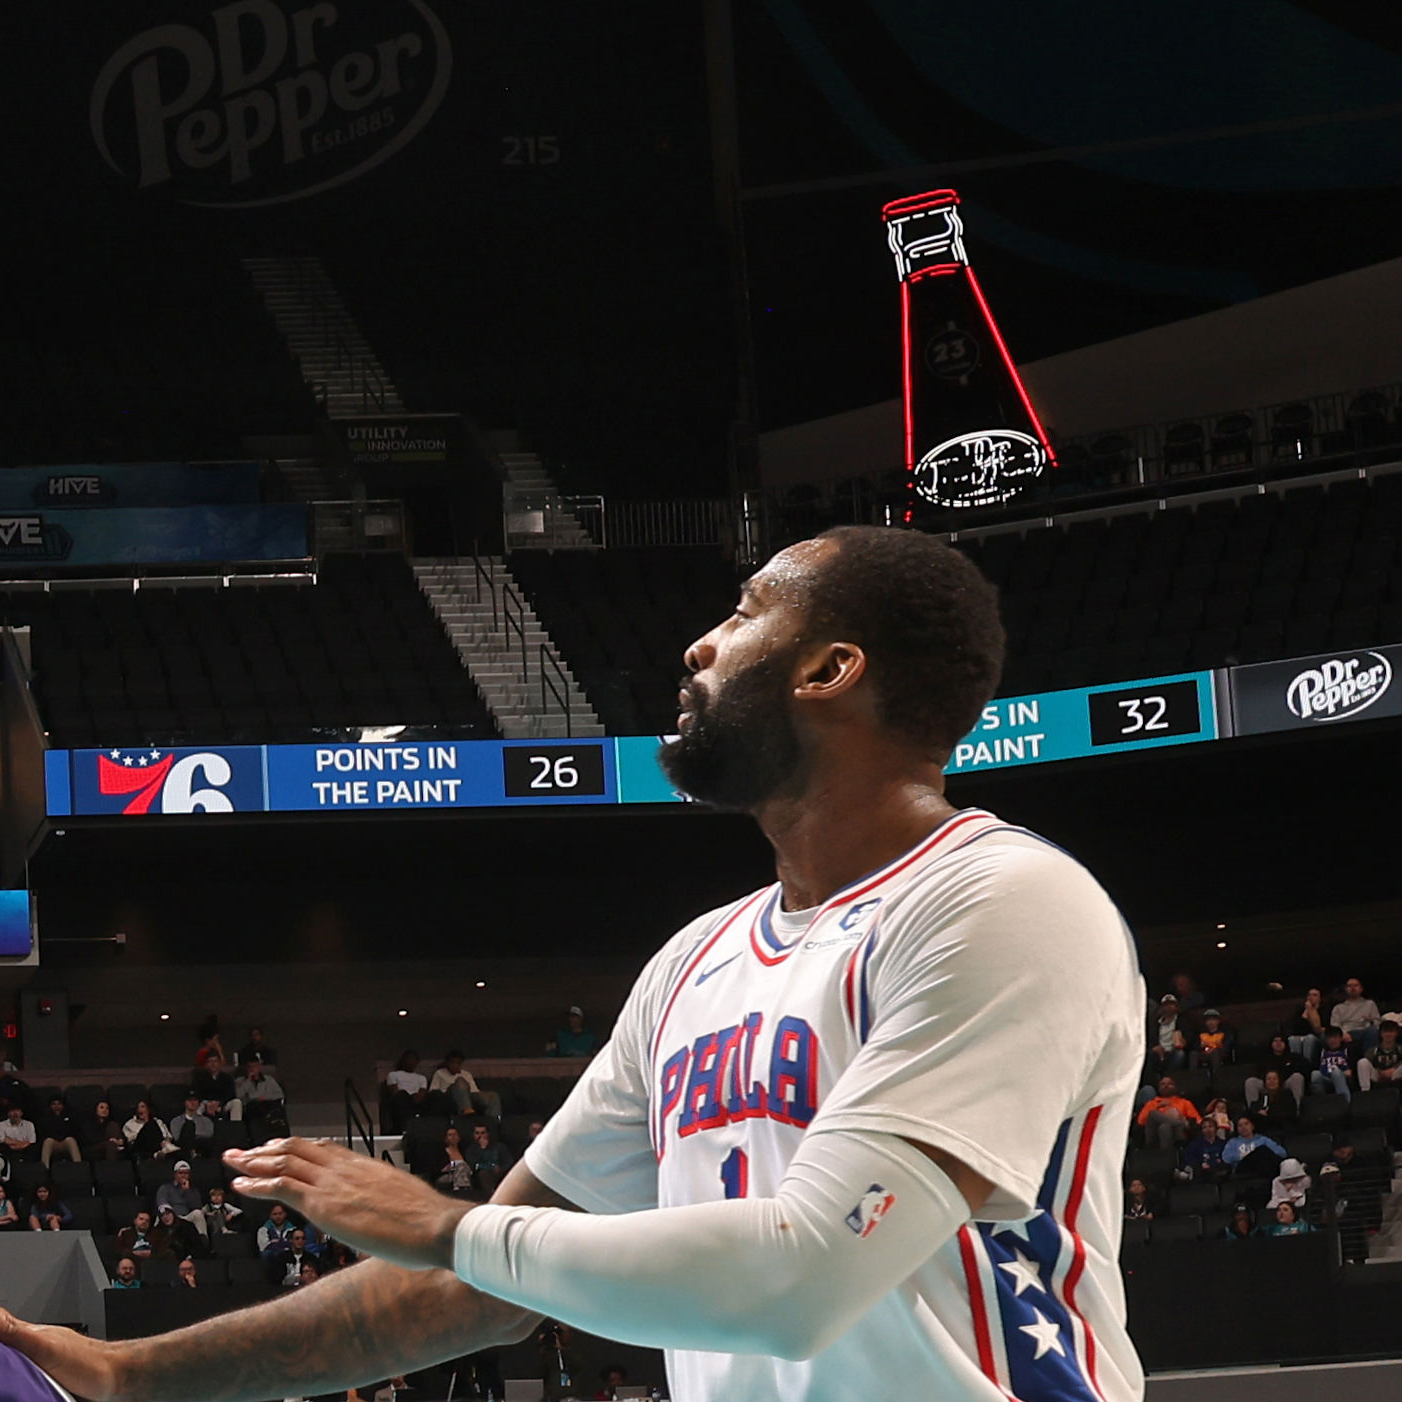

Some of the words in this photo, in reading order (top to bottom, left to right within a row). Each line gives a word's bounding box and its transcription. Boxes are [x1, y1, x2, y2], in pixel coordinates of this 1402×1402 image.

[212, 0, 338, 97] Dr
[89, 23, 423, 190] Pepper
[500, 135, 560, 165] 215
[347, 426, 409, 439] UTILITY
[49, 476, 102, 495] HIVE
[1321, 658, 1359, 690] Dr
[1287, 665, 1384, 720] Pepper
[1008, 700, 1040, 727] IN
[1118, 696, 1169, 734] 32
[315, 747, 421, 773] POINTS
[427, 746, 457, 769] IN
[955, 733, 1045, 768] PAINT
[529, 756, 579, 789] 26
[312, 780, 370, 805] THE
[377, 777, 463, 804] PAINT
